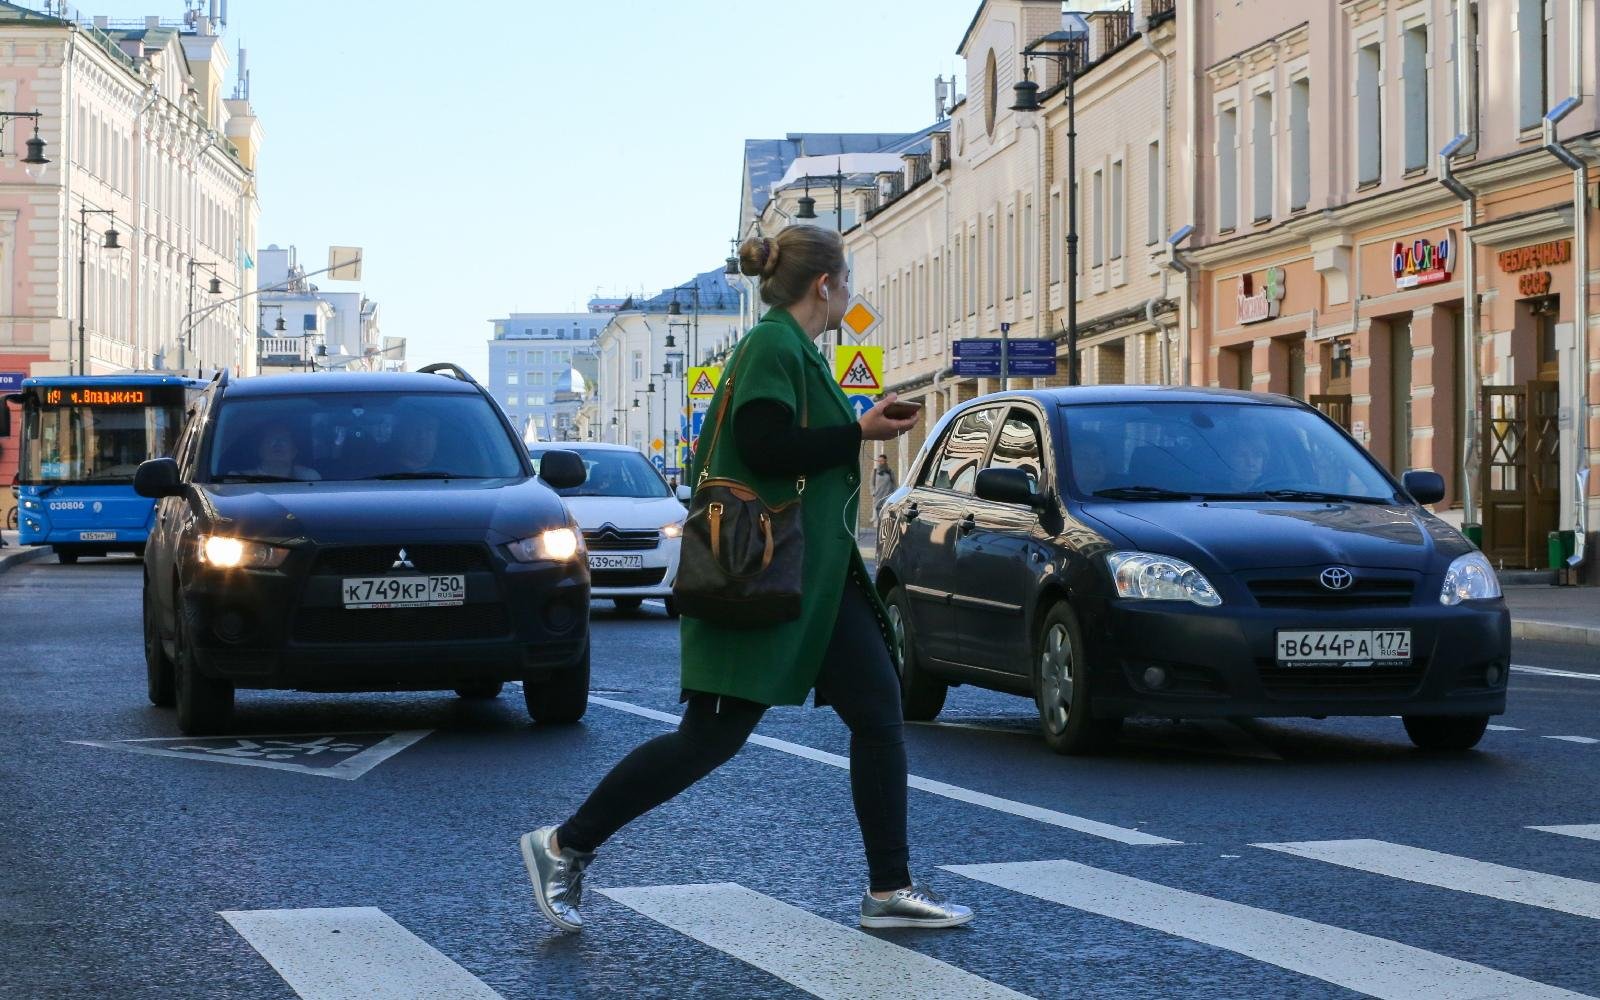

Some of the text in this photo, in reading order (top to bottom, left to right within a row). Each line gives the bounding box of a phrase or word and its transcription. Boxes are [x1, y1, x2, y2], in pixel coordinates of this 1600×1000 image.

[1498, 240, 1567, 272] ЧЕБУРЕЧНАЯ
[1519, 272, 1549, 295] СССР
[50, 502, 84, 510] 030806
[349, 577, 460, 600] К749КР 750
[1285, 632, 1406, 657] В644РА 177
